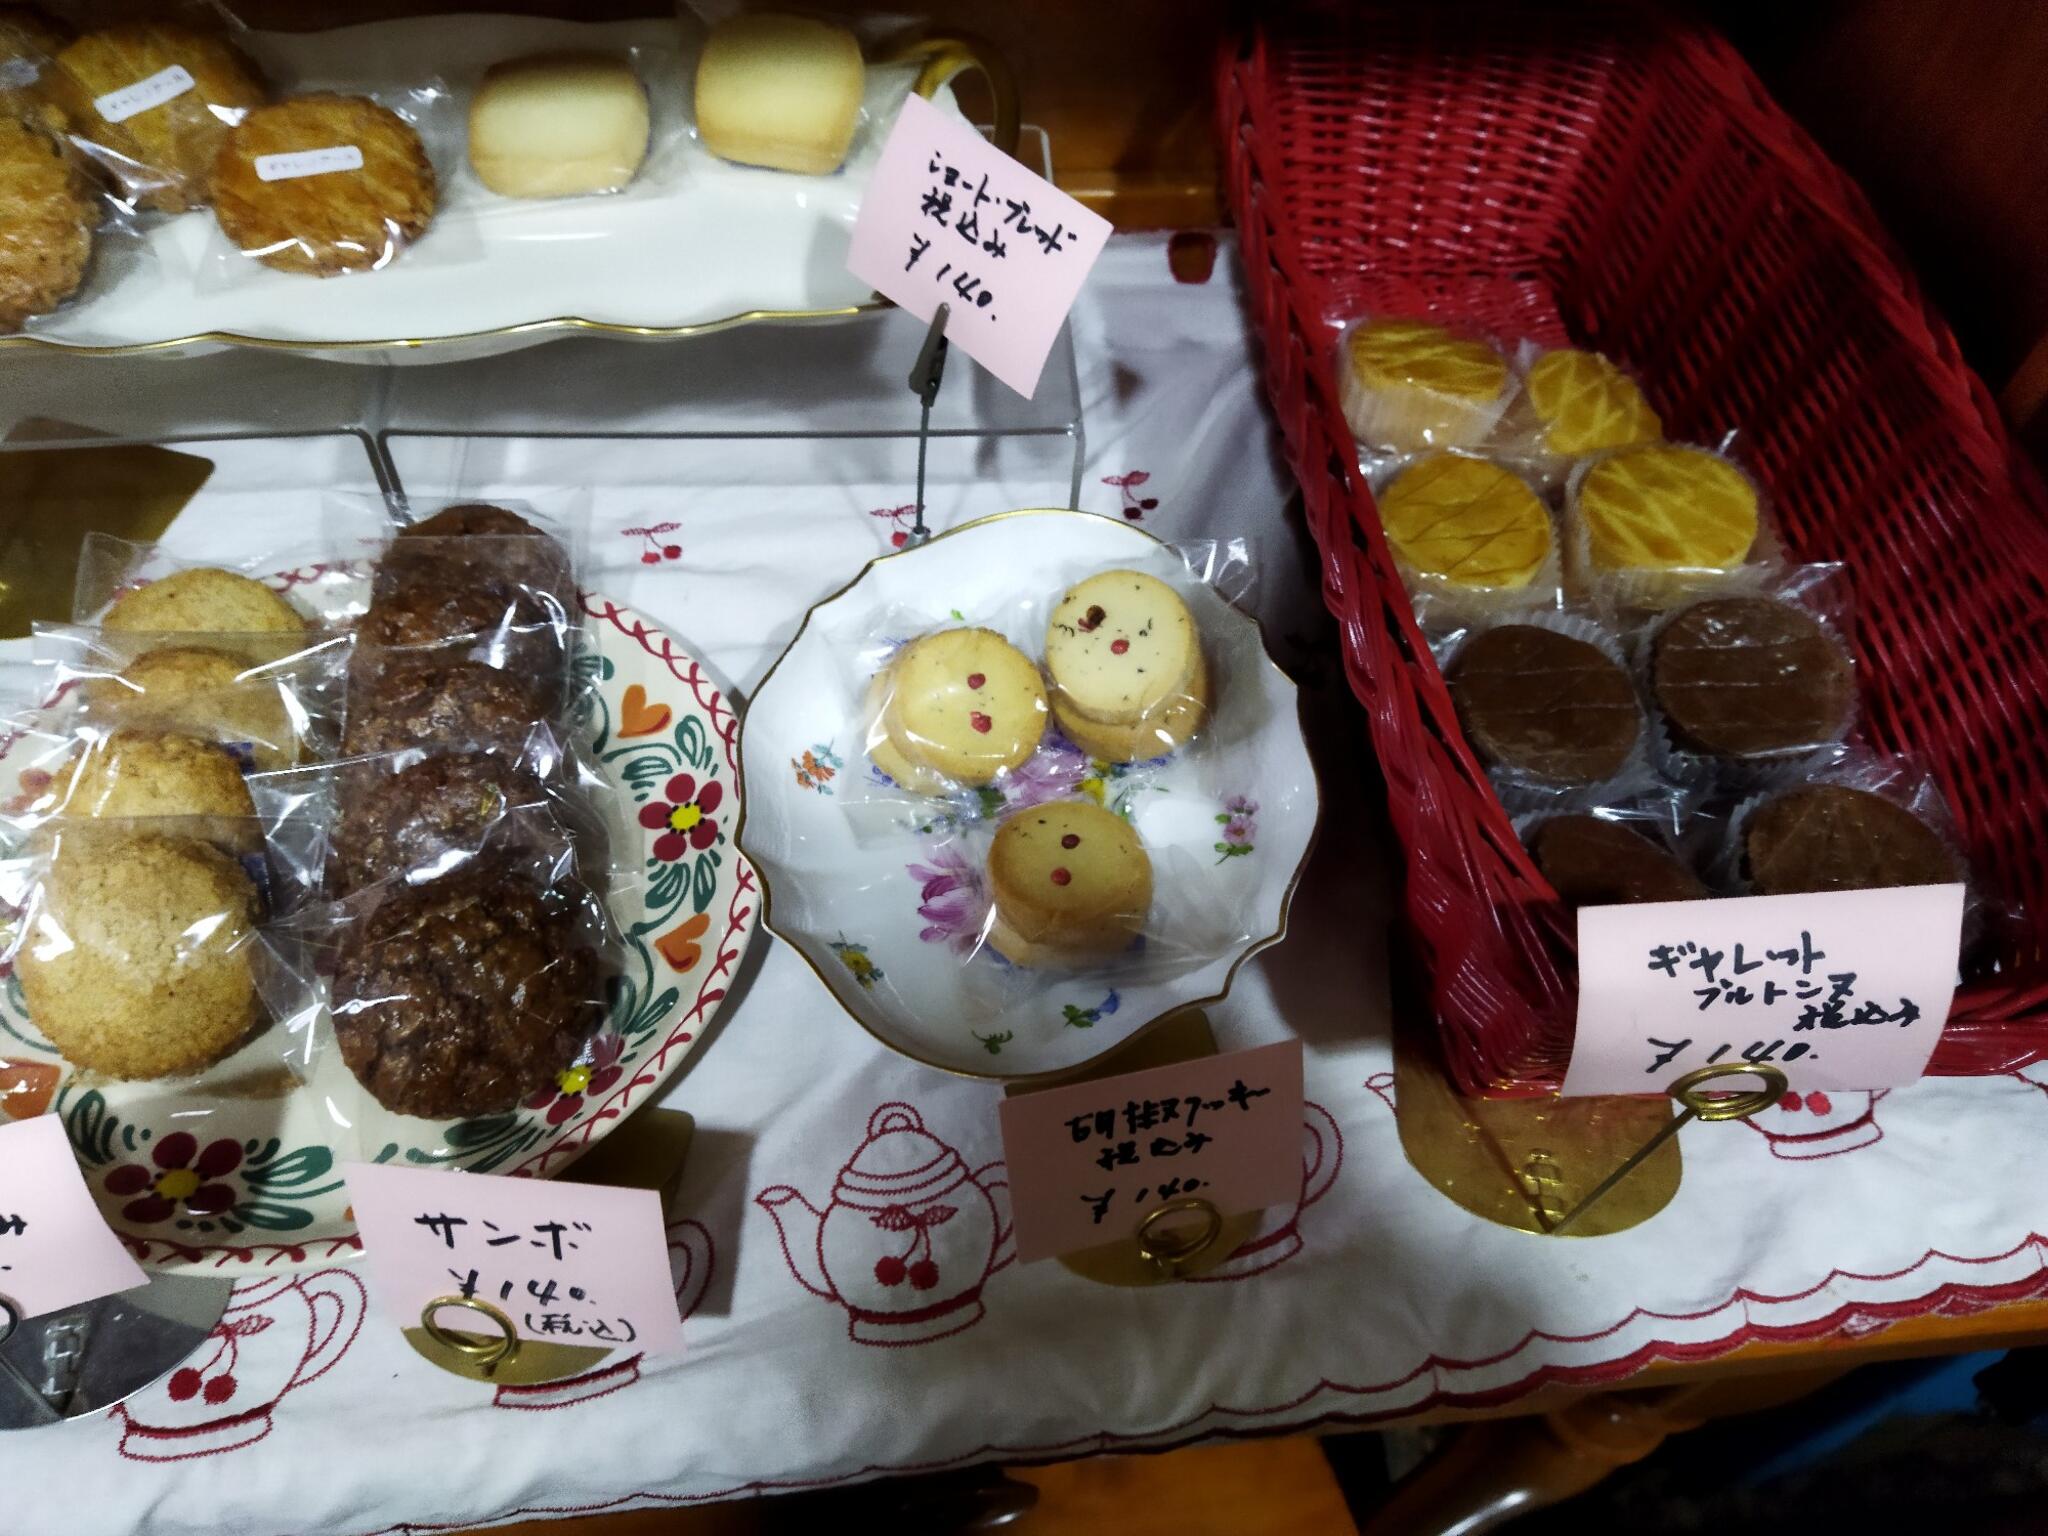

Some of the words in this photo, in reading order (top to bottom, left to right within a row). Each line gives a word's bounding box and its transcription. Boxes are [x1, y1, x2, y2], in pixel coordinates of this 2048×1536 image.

[1648, 931, 1826, 983] ギャレット
[414, 1212, 592, 1261] サンボ
